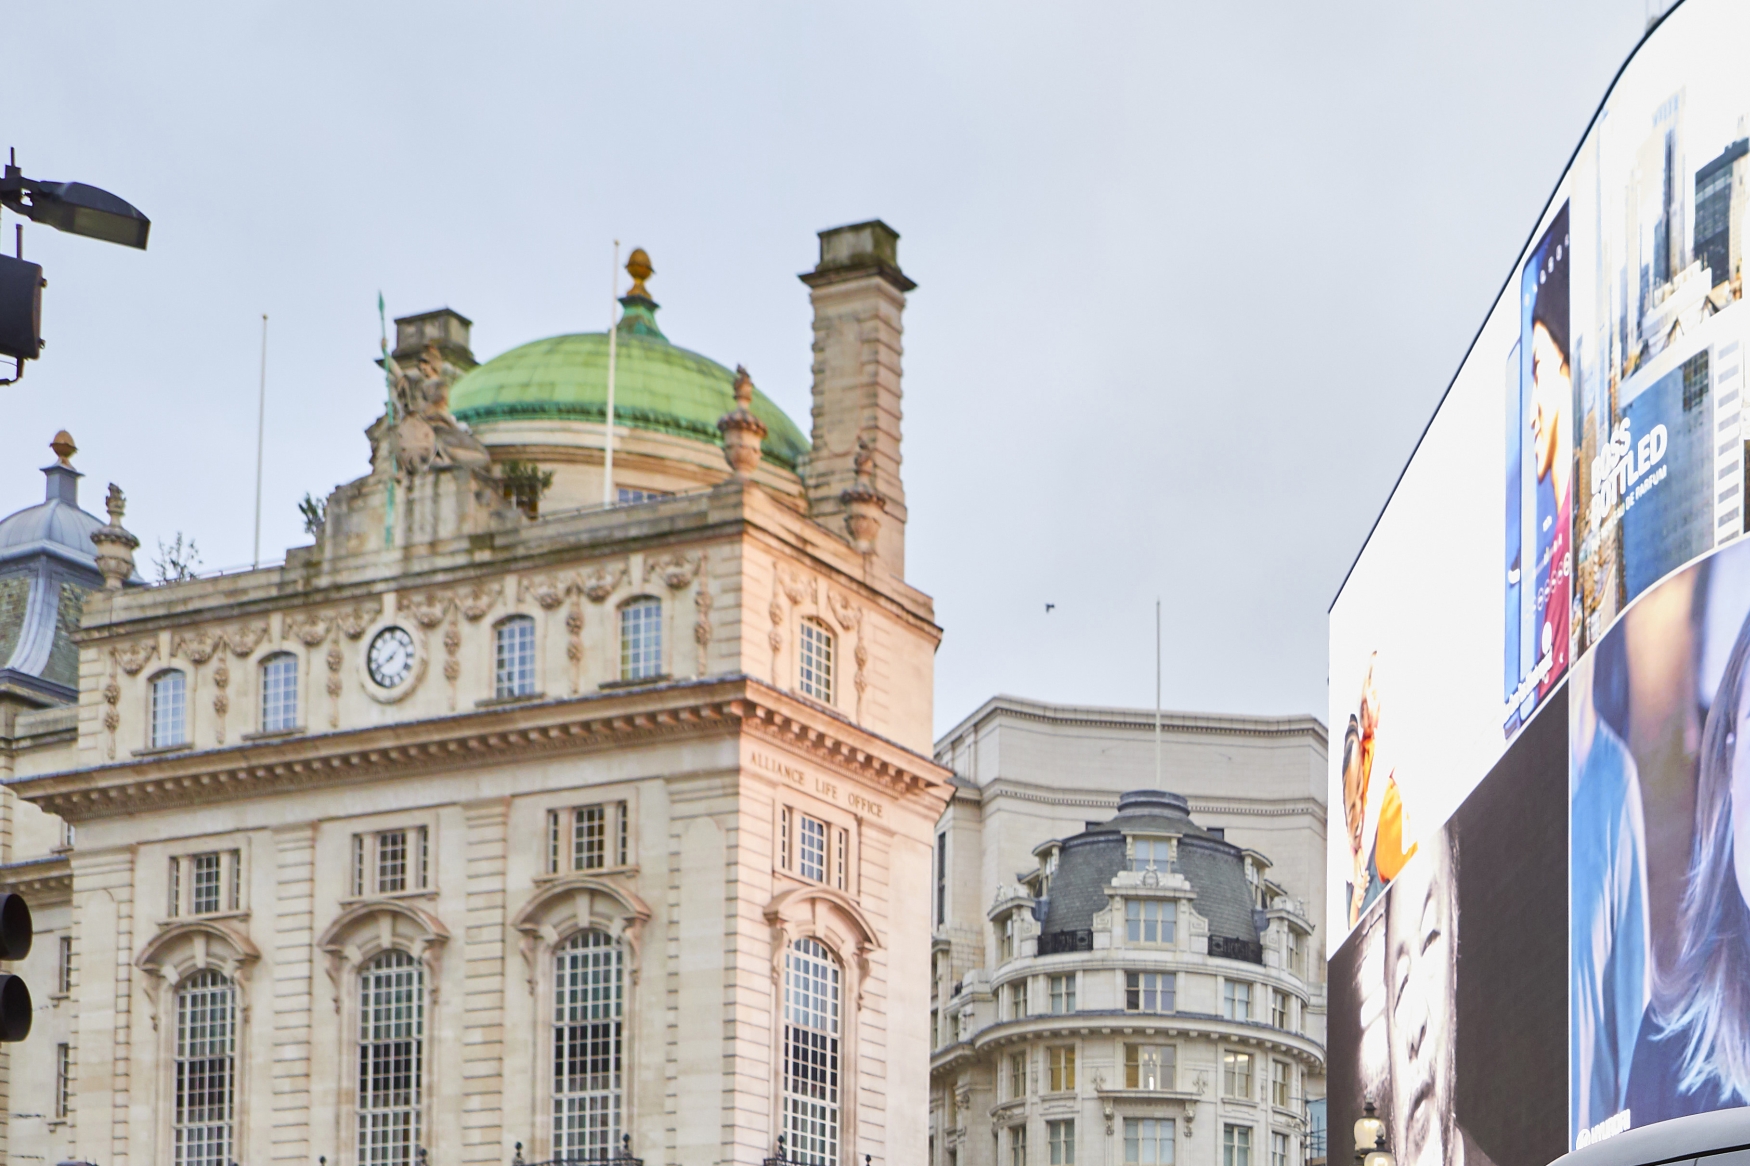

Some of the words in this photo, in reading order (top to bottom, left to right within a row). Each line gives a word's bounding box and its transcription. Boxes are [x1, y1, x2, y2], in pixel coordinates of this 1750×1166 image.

[1591, 416, 1631, 495] BOSS
[1591, 424, 1668, 533] BOTTLED
[751, 752, 804, 786] ALLIANCE
[815, 777, 838, 800] LIFE
[848, 792, 883, 819] OFFICE
